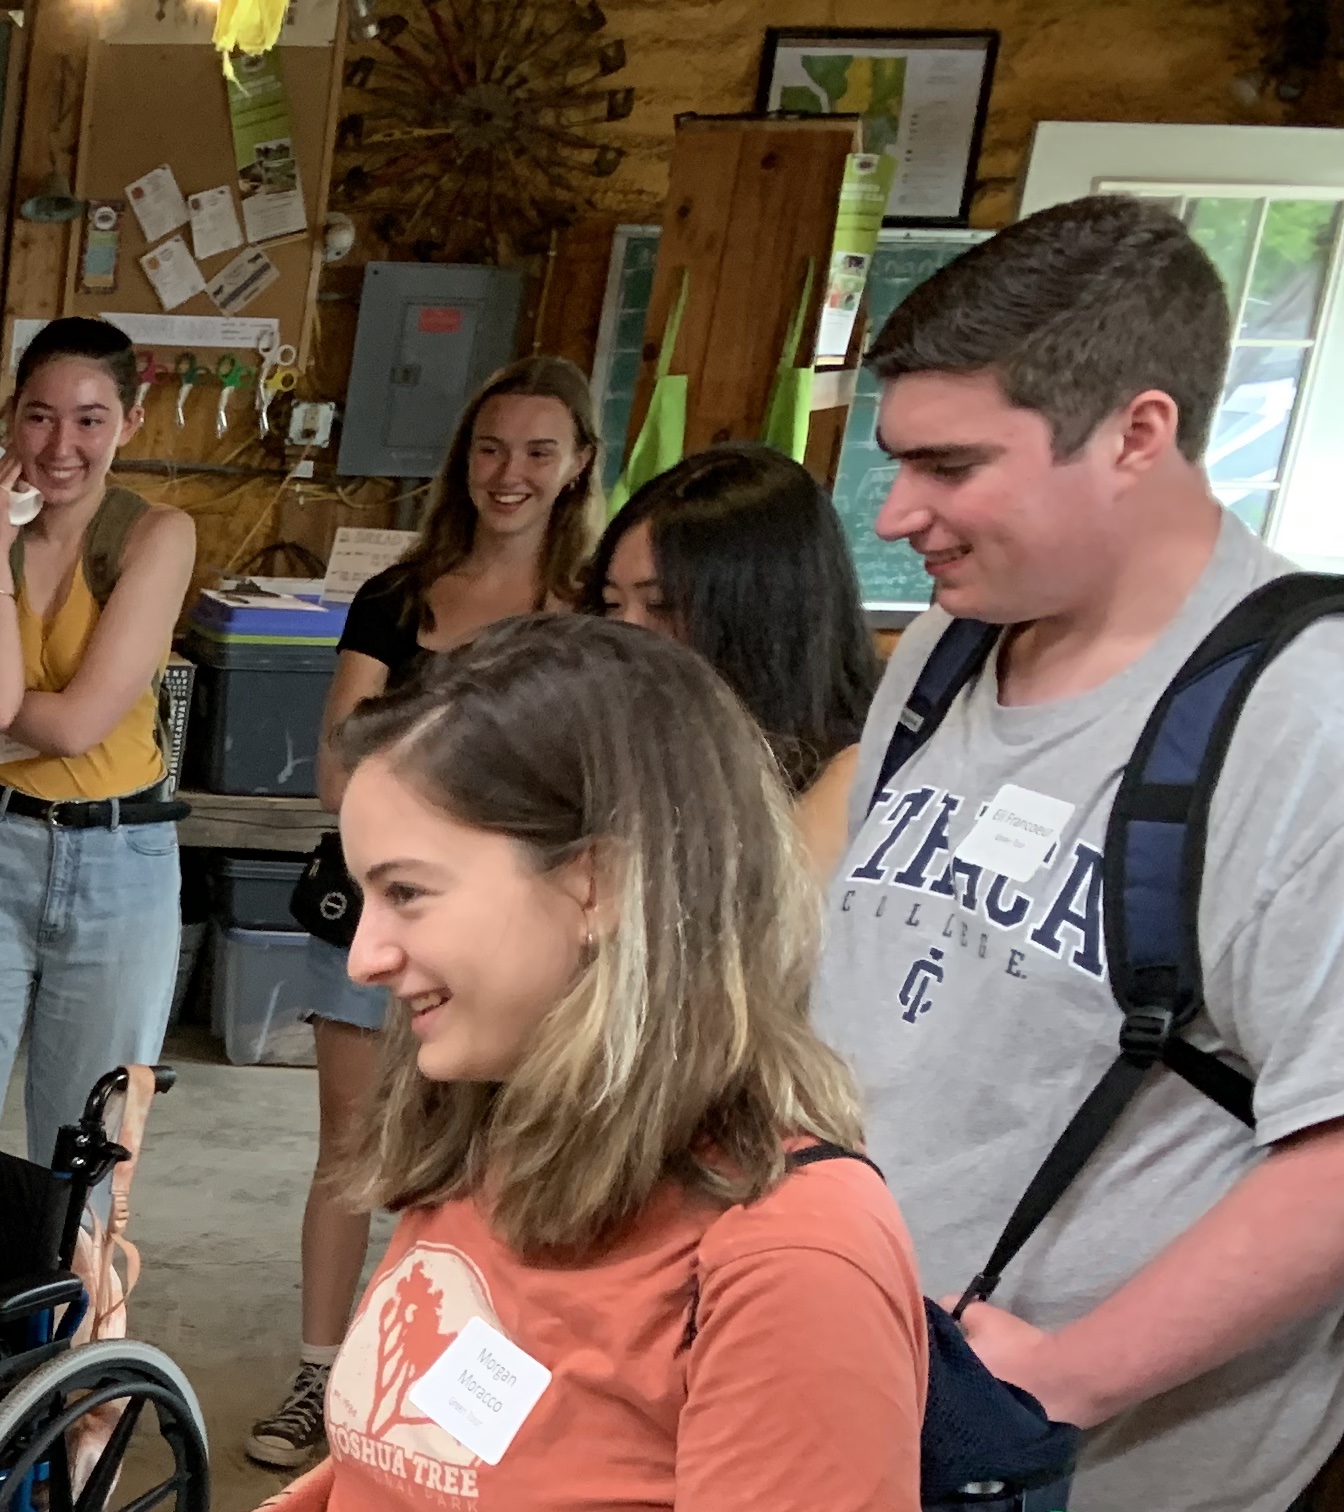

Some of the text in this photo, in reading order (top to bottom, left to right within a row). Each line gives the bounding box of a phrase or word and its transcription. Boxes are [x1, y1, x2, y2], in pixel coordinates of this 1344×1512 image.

[846, 784, 1106, 982] THCA
[457, 1369, 504, 1413] Moracco
[477, 1347, 517, 1388] Morgan
[329, 1423, 480, 1499] JOSHUA TREE
